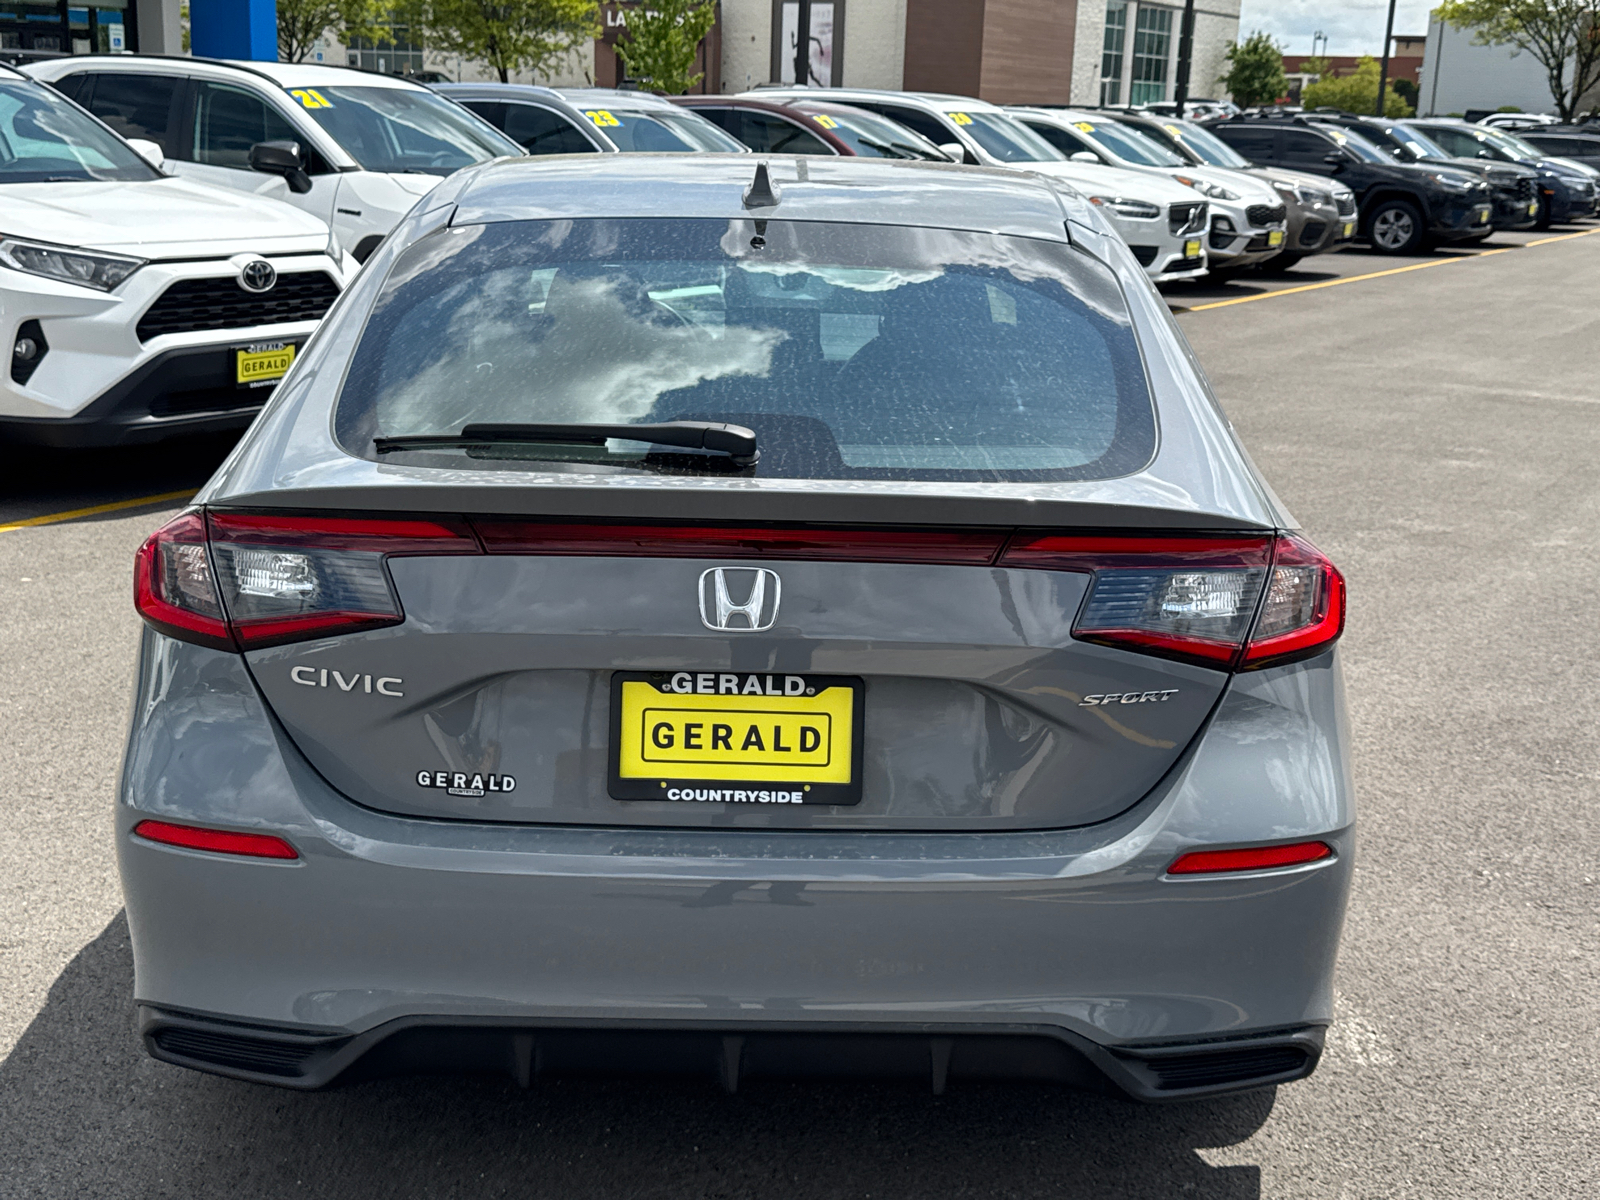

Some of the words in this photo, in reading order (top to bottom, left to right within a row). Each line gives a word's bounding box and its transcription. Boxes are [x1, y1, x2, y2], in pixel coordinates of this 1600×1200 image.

[291, 88, 333, 109] 21
[585, 110, 619, 127] 23
[244, 358, 287, 373] GERALD
[291, 665, 404, 697] CIVIC
[671, 672, 806, 696] GERALD
[1079, 689, 1180, 707] SPORT
[651, 722, 822, 753] GERALD
[417, 771, 516, 792] GERALD
[667, 788, 804, 804] COUNTRYSIDE
